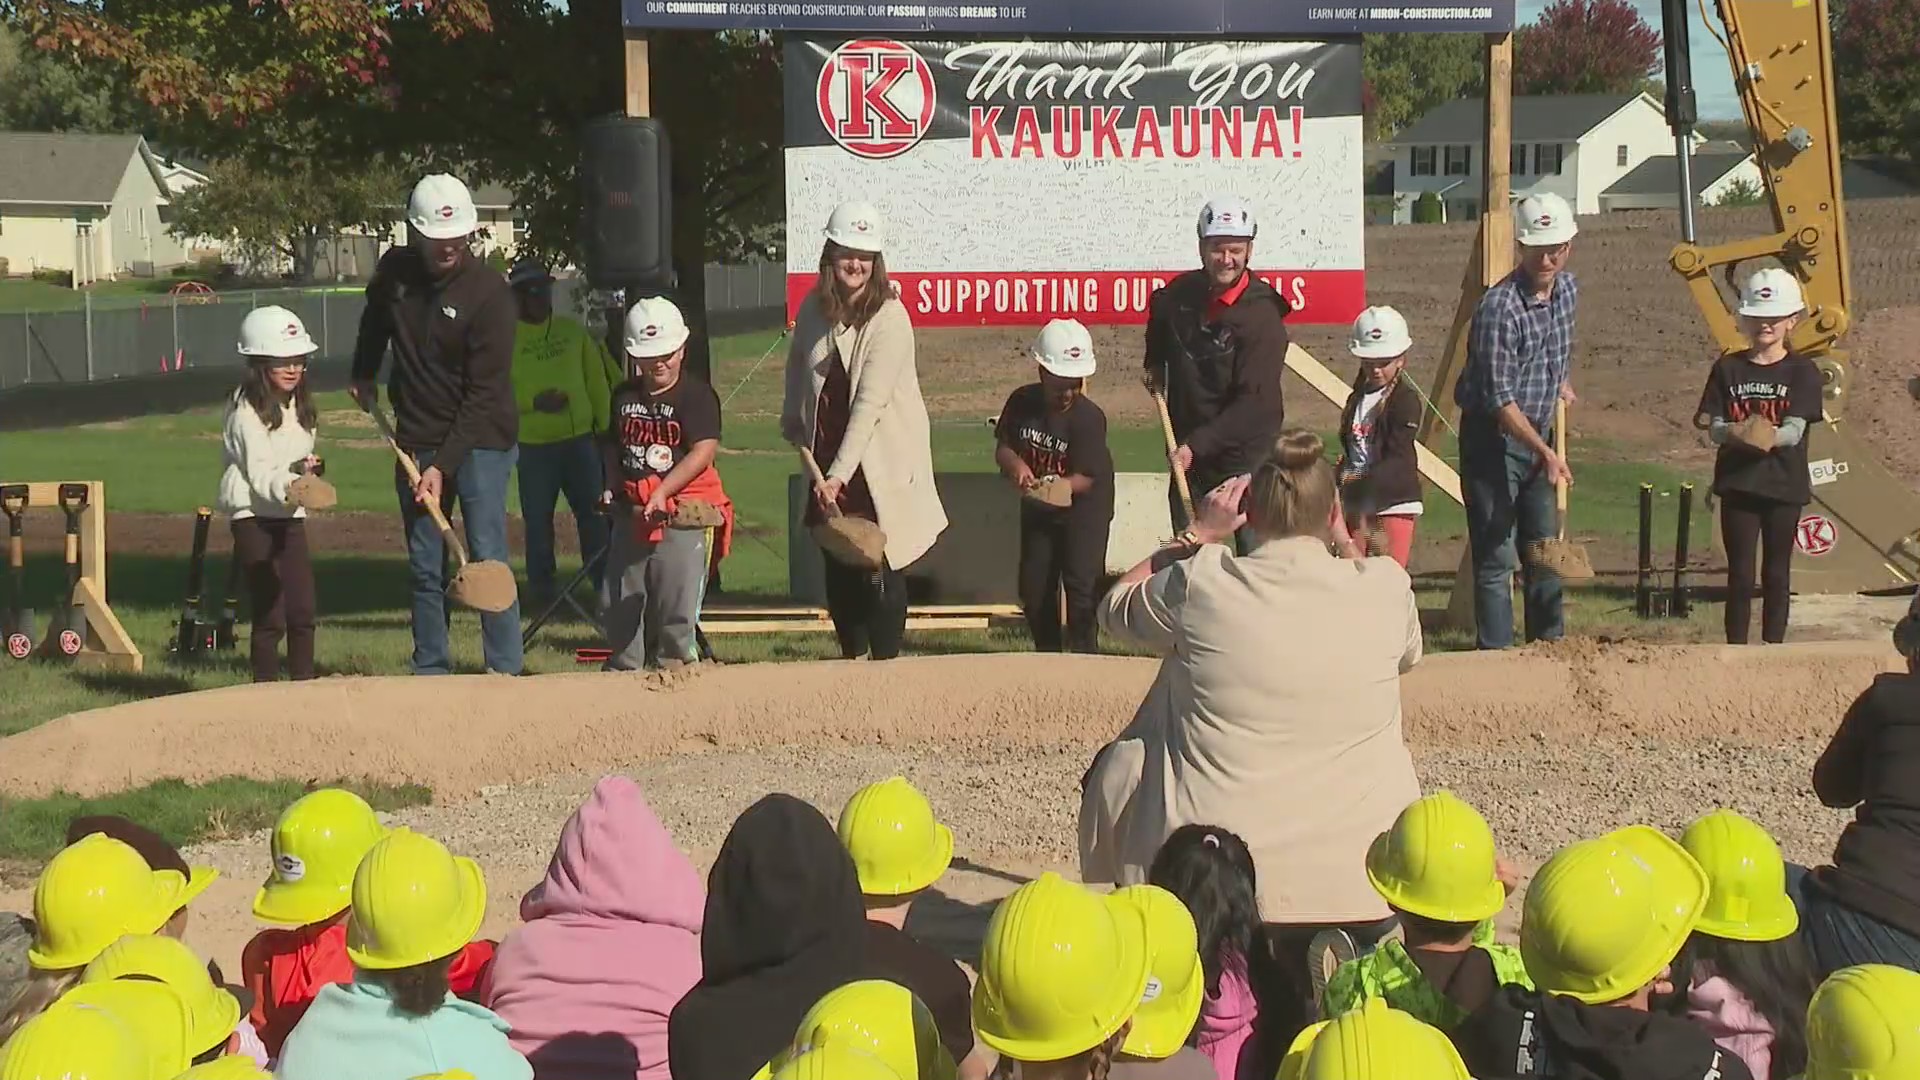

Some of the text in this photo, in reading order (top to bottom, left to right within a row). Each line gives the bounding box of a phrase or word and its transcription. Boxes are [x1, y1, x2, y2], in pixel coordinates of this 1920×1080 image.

[646, 2, 1027, 18] OUR COMMITMENT REACHES BEYOND CONSTRUCTION: OUR PASSION BRINGS DREAMS TO LIFE
[1308, 7, 1493, 20] LEARN MORE AT MIRON-CONSTRUCTION.COM
[943, 40, 1317, 110] Thank You
[837, 52, 920, 140] K
[969, 105, 1304, 158] KAUKAUNA!
[917, 277, 1098, 314] SUPPORTING
[1799, 519, 1832, 551] K
